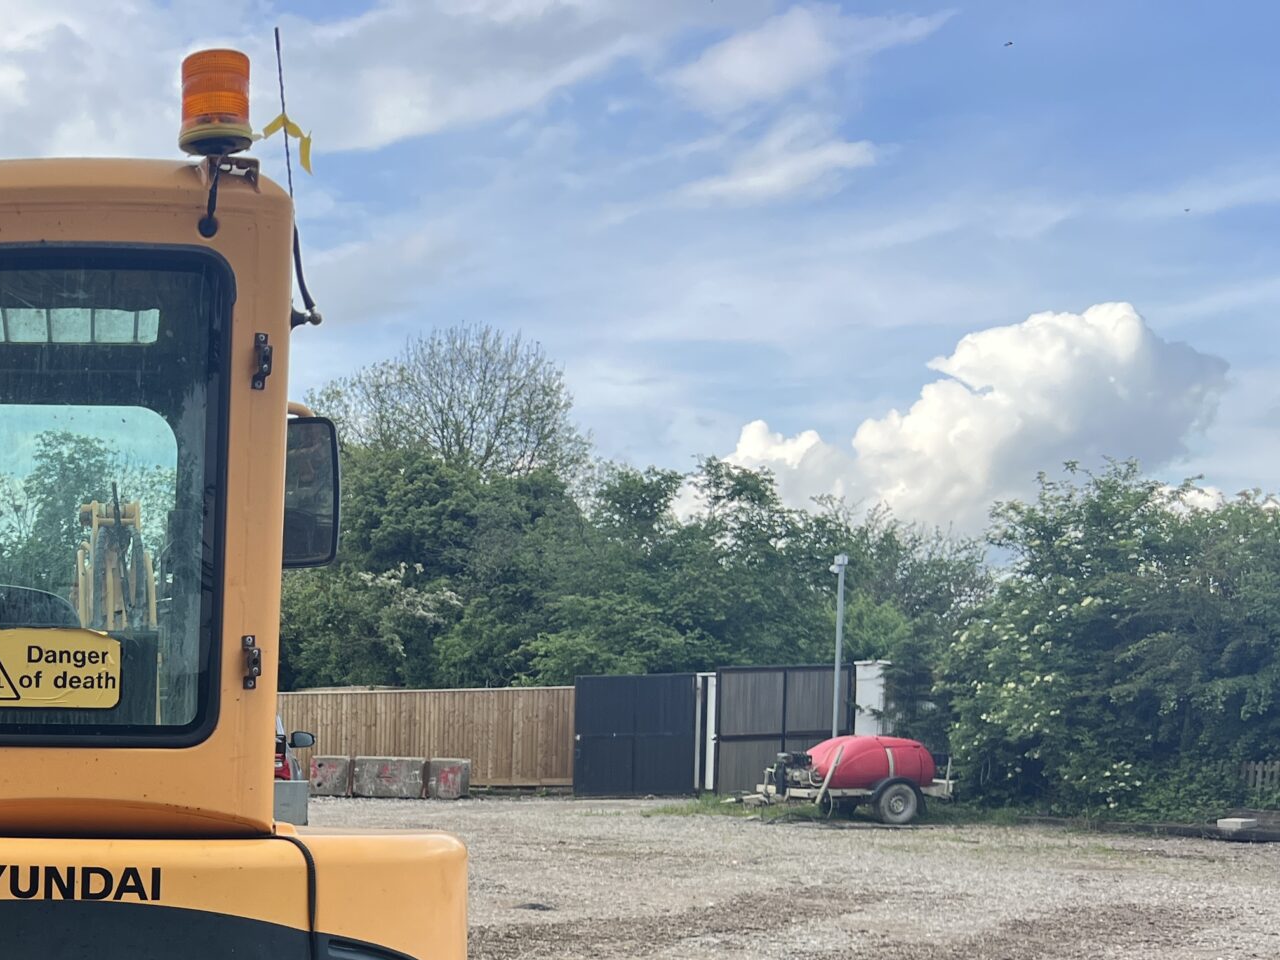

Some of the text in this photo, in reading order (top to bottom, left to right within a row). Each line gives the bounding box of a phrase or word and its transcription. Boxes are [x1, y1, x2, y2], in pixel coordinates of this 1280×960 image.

[27, 645, 108, 668] Danger
[19, 671, 116, 690] of death
